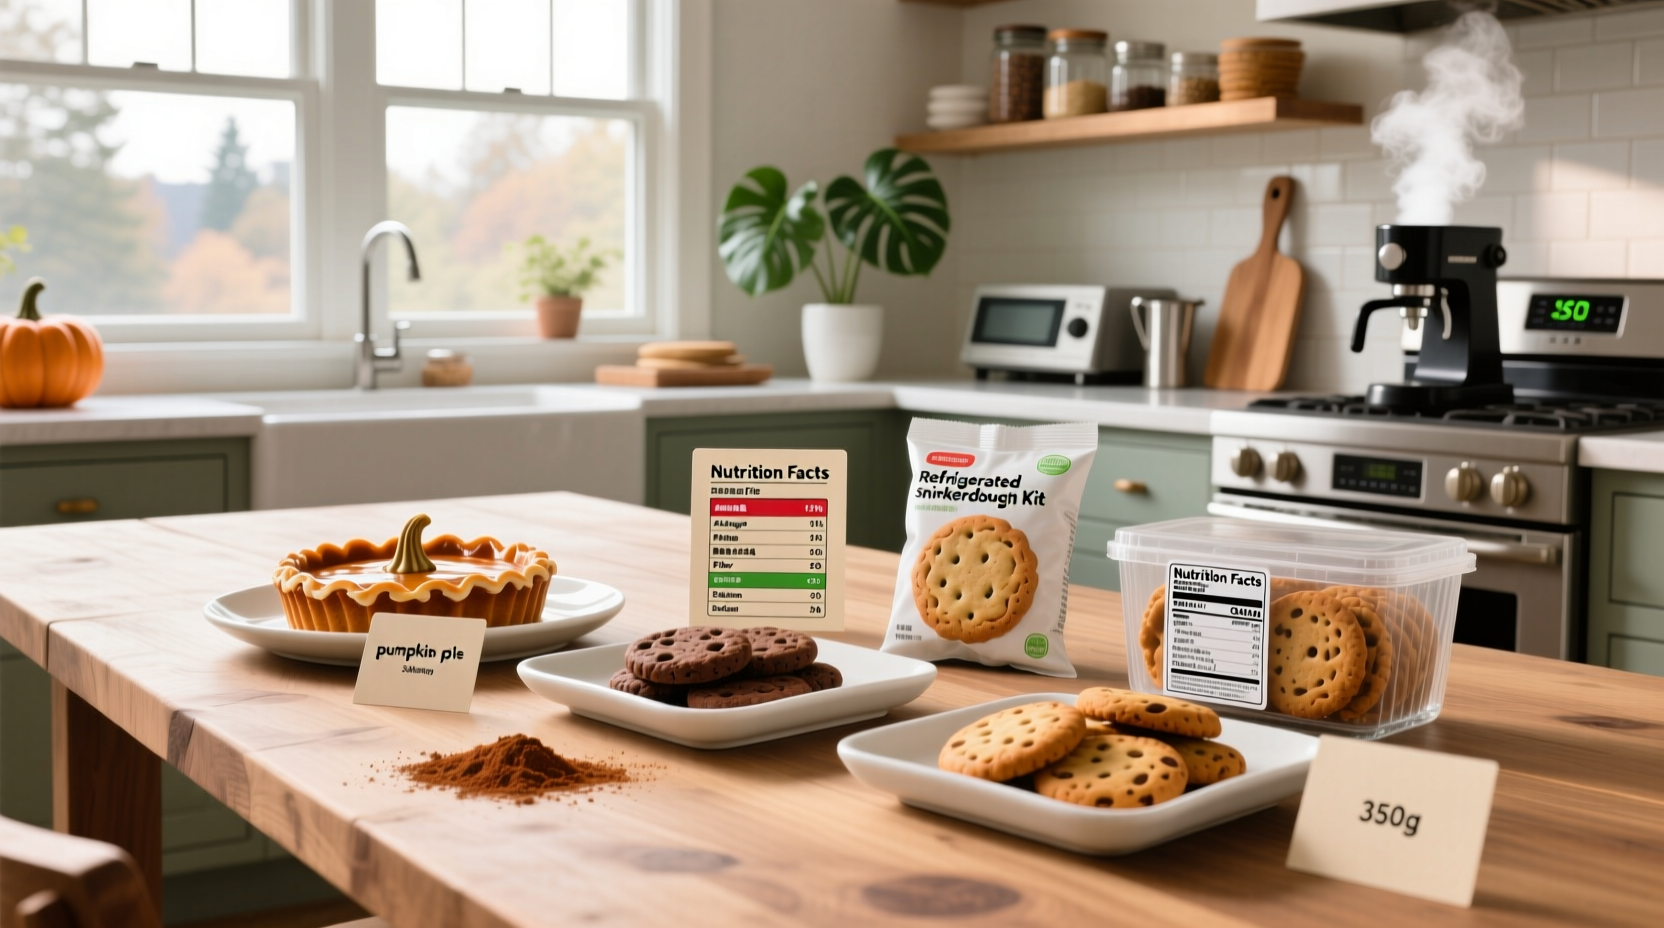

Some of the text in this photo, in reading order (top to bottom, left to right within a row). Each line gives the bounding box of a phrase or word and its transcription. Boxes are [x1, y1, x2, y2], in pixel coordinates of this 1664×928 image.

[711, 464, 830, 480] Nutrition Facts
[1022, 490, 1046, 507] Kit
[1230, 573, 1262, 587] Facts
[375, 643, 437, 662] pumpkin
[1359, 800, 1421, 837] 350g
